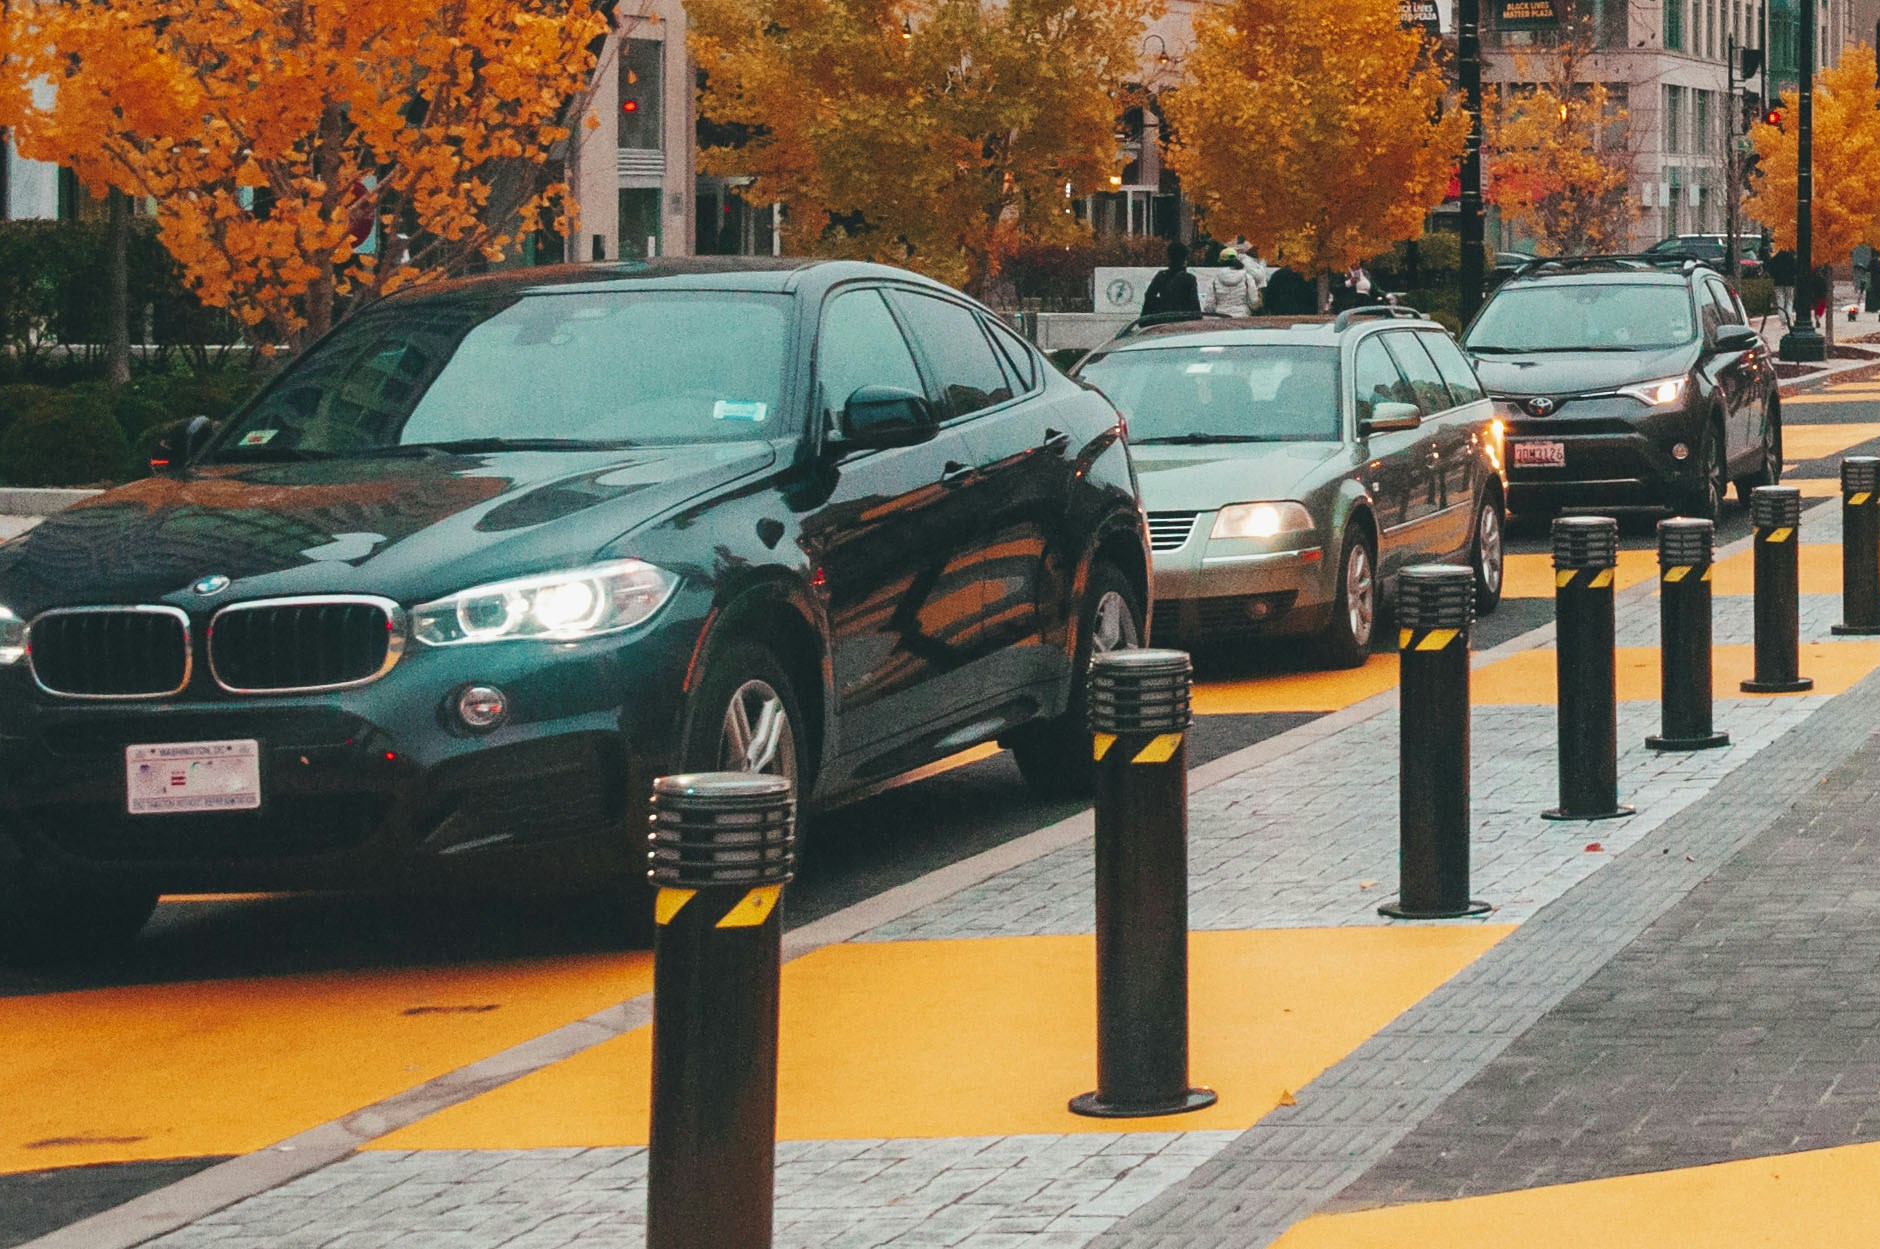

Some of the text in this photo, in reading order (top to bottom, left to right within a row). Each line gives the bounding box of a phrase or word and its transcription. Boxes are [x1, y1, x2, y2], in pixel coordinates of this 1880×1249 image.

[1506, 1, 1549, 11] BLACK LIVES
[1503, 9, 1553, 19] MATTER PLAZA
